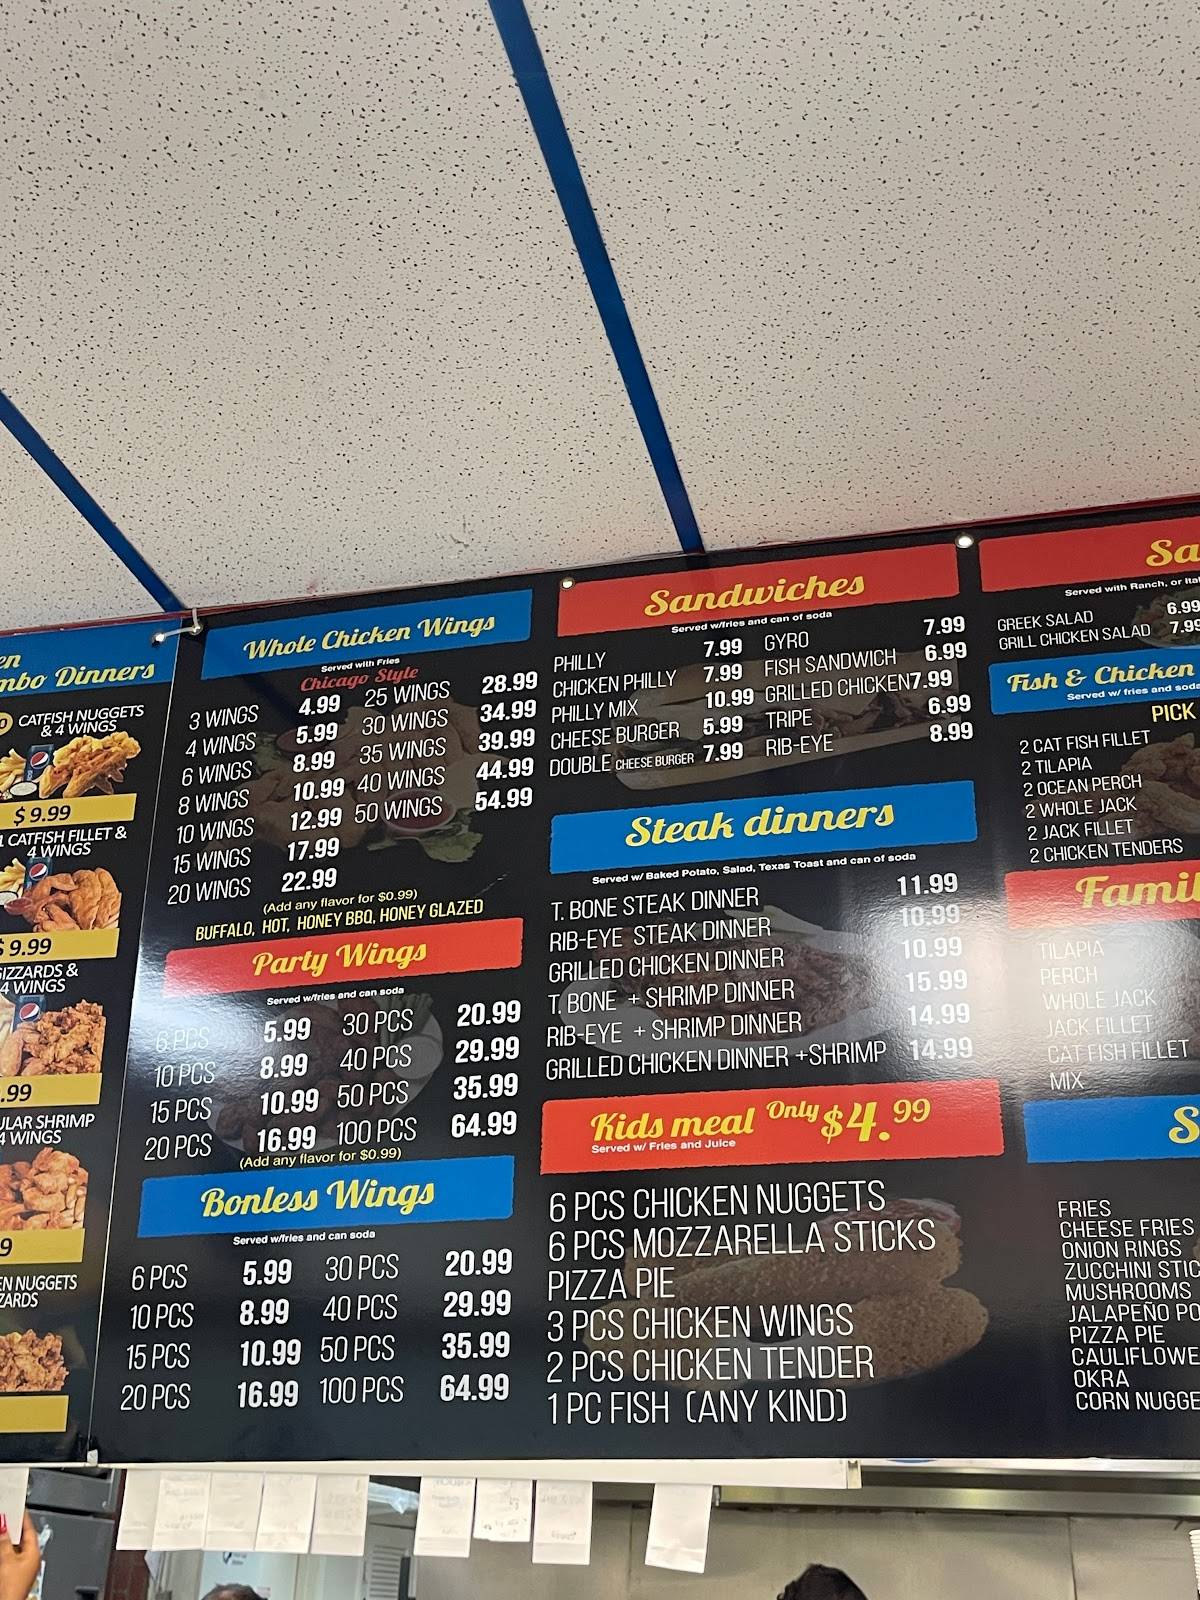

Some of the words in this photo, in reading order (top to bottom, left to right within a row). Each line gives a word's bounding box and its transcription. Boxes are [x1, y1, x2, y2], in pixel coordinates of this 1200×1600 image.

[644, 576, 864, 619] Sandwiches
[671, 623, 707, 633] Served
[710, 621, 745, 629] w/fries
[748, 617, 767, 625] and
[792, 613, 803, 621] of
[806, 611, 832, 620] soda
[765, 631, 809, 651] GYRO
[923, 616, 965, 635] 7.99
[998, 615, 1042, 631] GREEK
[1046, 610, 1093, 627] SALAD
[243, 635, 316, 659] Whole
[322, 626, 410, 650] Chicken
[417, 617, 495, 637] Wings
[999, 635, 1037, 650] GRILL
[1040, 629, 1099, 646] CHICKEN
[1102, 624, 1151, 640] SALAD
[321, 662, 353, 673] Served
[355, 660, 374, 668] with
[377, 658, 400, 666] Fries
[554, 652, 606, 672] PHILLY
[704, 638, 742, 657] 7.99
[765, 657, 800, 677] FISH
[805, 648, 896, 673] SANDWICH
[925, 642, 967, 661] 6.99
[55, 664, 154, 687] Dinners
[300, 674, 371, 691] Chicago
[375, 666, 418, 684] Style
[364, 688, 387, 707] 25
[394, 681, 450, 704] WINGS
[482, 671, 538, 694] 28.99
[553, 675, 619, 698] CHICKEN
[624, 669, 676, 691] PHILLY
[703, 663, 742, 683] 7.99
[1007, 673, 1058, 692] Fish
[1065, 669, 1087, 687] &
[1095, 663, 1195, 684] Chicken
[19, 711, 73, 729] CATFISH
[76, 705, 144, 724] NUGGETS
[189, 712, 200, 730] 3
[206, 705, 259, 728] WINGS
[299, 694, 340, 715] 4.99
[765, 708, 812, 729] TRIPE
[928, 694, 971, 714] 6.99
[1152, 702, 1196, 722] PICK
[41, 725, 52, 737] &
[55, 724, 64, 735] 4
[68, 718, 119, 736] WINGS
[766, 734, 834, 756] RIB-EYE
[930, 722, 973, 742] 8.99
[550, 754, 611, 776] DOUBLE
[615, 756, 653, 770] CHEESE
[655, 753, 694, 767] BURGER
[703, 742, 743, 762] 7.99
[1021, 761, 1031, 775] 2
[1035, 756, 1092, 774] TILAPIA
[1023, 782, 1033, 797] 2
[1037, 778, 1088, 796] OCEAN
[1092, 774, 1142, 791] PERCH
[354, 803, 378, 823] 50
[384, 796, 442, 820] WINGS
[475, 787, 532, 811] 54.99
[625, 812, 734, 846] Steak
[744, 804, 894, 836] dinners
[27, 846, 37, 860] 4
[41, 842, 91, 858] WINGS
[1030, 848, 1040, 863] 2
[1044, 843, 1108, 862] CHICKEN
[1111, 838, 1183, 857] TENDERS
[592, 874, 628, 884] Served
[646, 870, 679, 880] Baked
[682, 868, 719, 877] Potato,
[723, 864, 756, 874] Salad,
[758, 863, 790, 871] Texas
[793, 859, 824, 868] Toast
[826, 857, 847, 866] and
[873, 854, 885, 862] of
[888, 853, 916, 862] soda
[551, 902, 564, 921] T.
[570, 897, 617, 920] BONE
[623, 892, 685, 915] STEAK
[692, 887, 759, 910] DINNER
[897, 873, 958, 896] 11.99
[196, 922, 255, 941] BUFFALO,
[262, 917, 290, 934] HOT,
[297, 912, 342, 930] HONEY
[345, 909, 376, 925] BBQ,
[380, 904, 426, 922] HONEY
[429, 899, 483, 918] GLAZED
[252, 951, 328, 977] Party
[336, 942, 426, 969] Wings
[549, 958, 623, 983] GRILLED
[629, 952, 709, 977] CHICKEN
[715, 947, 784, 971] DINNER
[901, 936, 962, 960] 10.99
[13, 978, 65, 994] WINGS
[1040, 966, 1098, 986] PERCH
[267, 995, 301, 1005] Served
[303, 993, 335, 1002] w/fries
[338, 990, 357, 999] and
[379, 987, 404, 996] soda
[337, 1084, 364, 1108] 50
[369, 1080, 409, 1106] PCS
[453, 1073, 518, 1100] 35.99
[1048, 1069, 1087, 1090] MIX
[151, 1100, 170, 1123] 15
[175, 1097, 212, 1122] PCS
[261, 1088, 319, 1115] 10.99
[591, 1113, 663, 1141] Kids
[671, 1107, 755, 1137] meal
[766, 1101, 820, 1123] Only
[592, 1143, 630, 1153] Served
[649, 1142, 677, 1150] Fries
[680, 1140, 702, 1149] and
[705, 1139, 736, 1148] Juice
[201, 1186, 318, 1217] Bonless
[326, 1179, 434, 1215] Wings
[1058, 1200, 1111, 1218] FRIES
[549, 1231, 565, 1261] 6
[574, 1229, 624, 1260] PCS
[634, 1222, 825, 1258] MOZZARELLA
[834, 1219, 936, 1252] STICKS
[1060, 1220, 1134, 1238] CHEESE
[1140, 1218, 1194, 1236] FRIES
[1062, 1241, 1119, 1259] ONION
[1125, 1239, 1182, 1257] RINGS
[548, 1269, 627, 1301] PIZZA
[636, 1267, 675, 1298] PIE
[1066, 1281, 1191, 1301] MUSHROOMS
[1070, 1326, 1129, 1344] PIZZA
[1135, 1325, 1165, 1343] PIE
[547, 1351, 563, 1383] 2
[572, 1350, 623, 1382] PCS
[633, 1347, 751, 1381] CHICKEN
[759, 1346, 874, 1379] TENDER
[1074, 1369, 1129, 1388] OKRA
[120, 1384, 147, 1410] 20
[152, 1383, 191, 1410] PCS
[238, 1380, 298, 1408] 16.99
[320, 1377, 356, 1403] 100
[362, 1376, 404, 1403] PCS
[440, 1373, 509, 1401] 64.99
